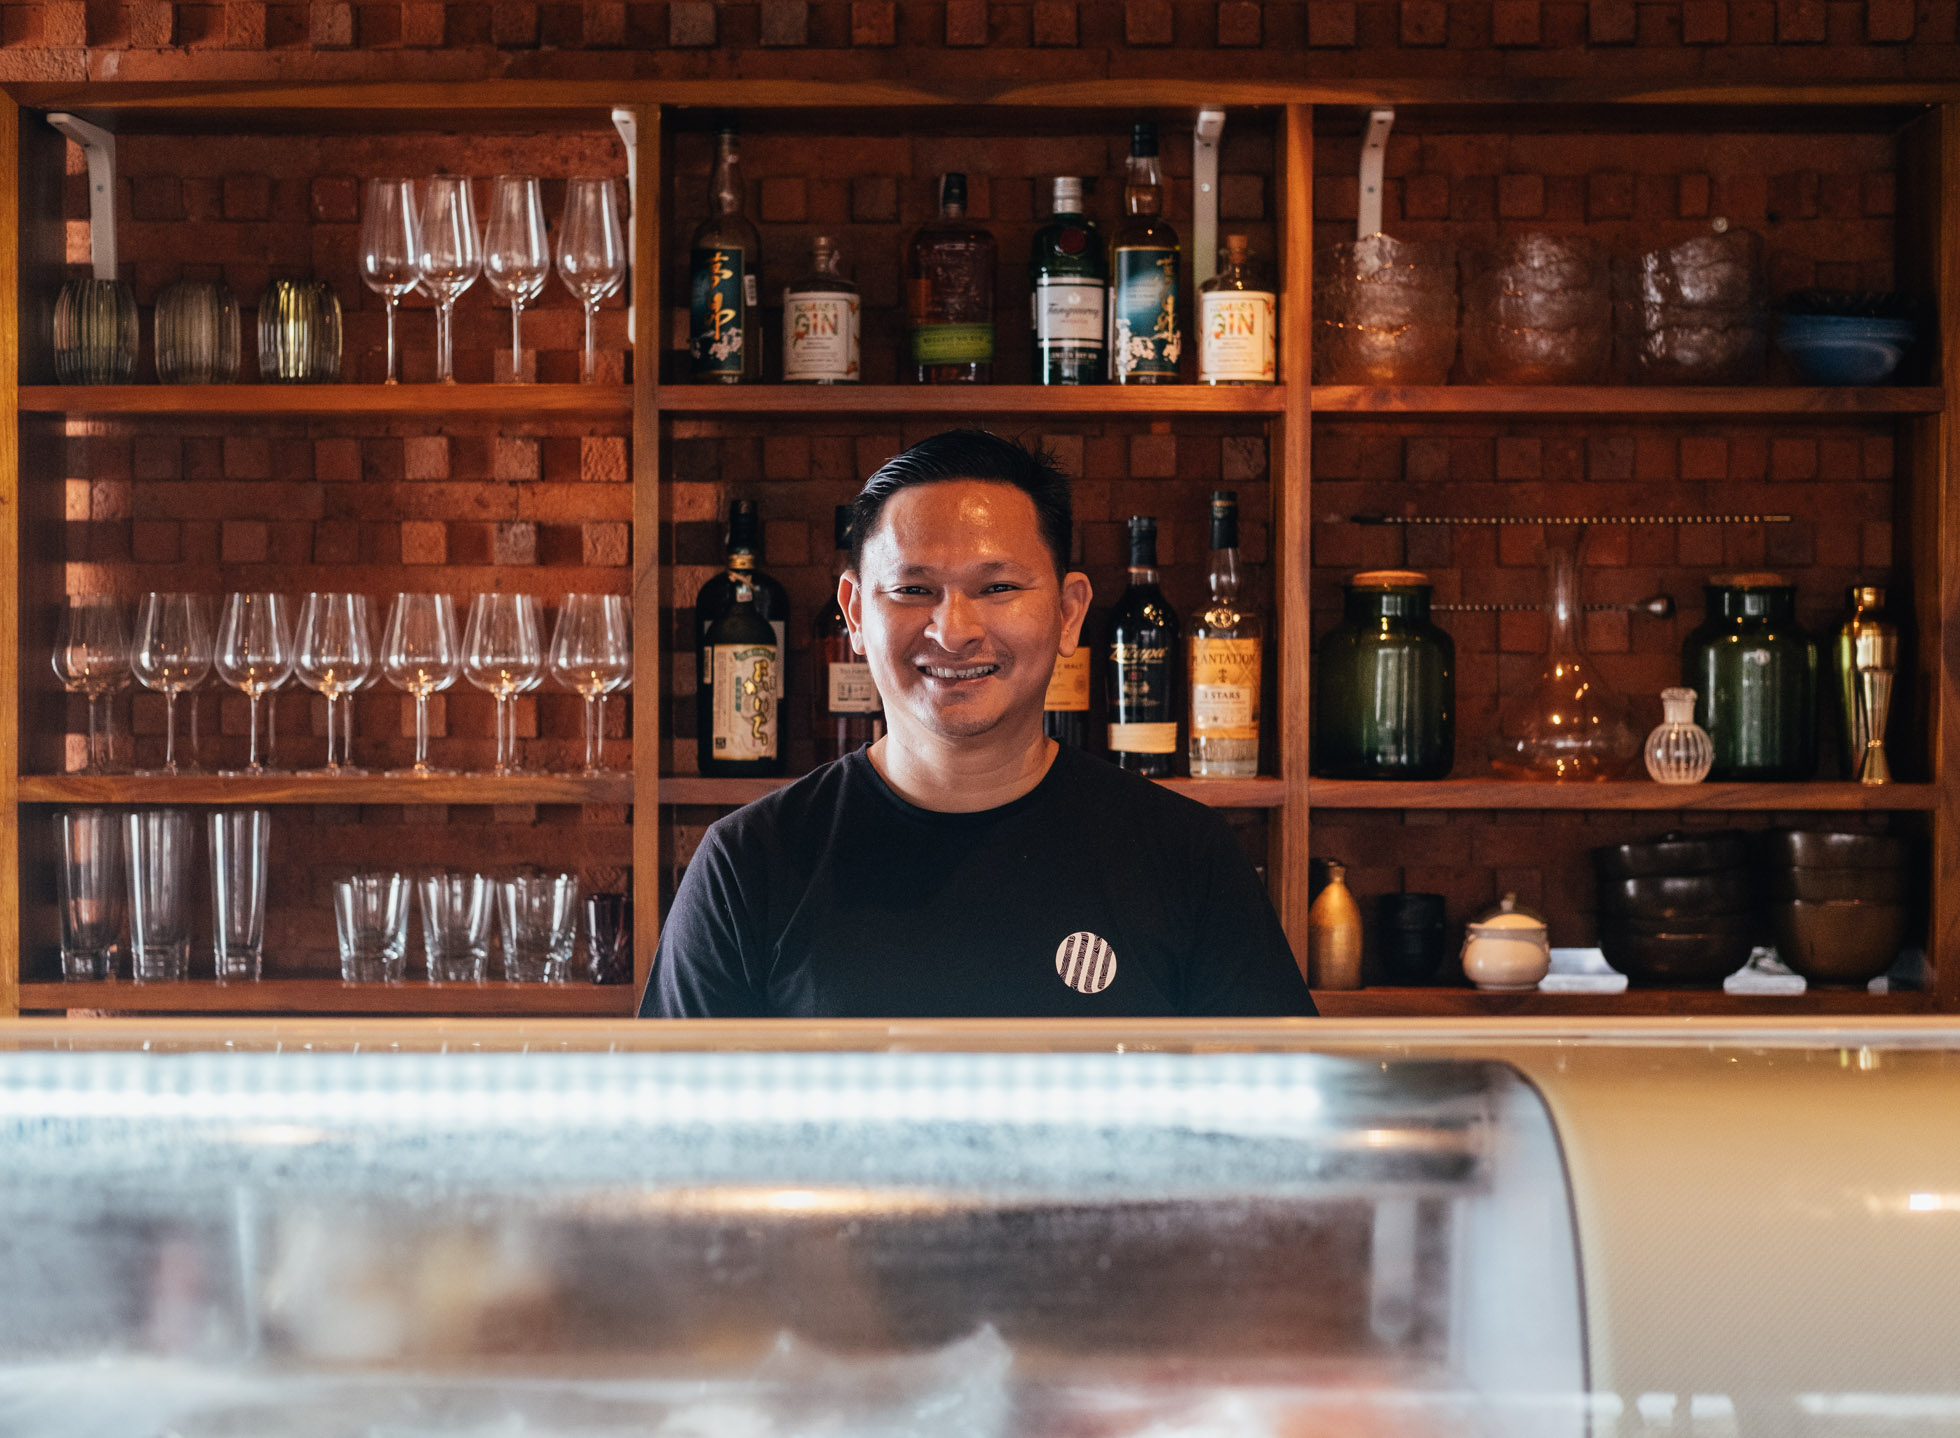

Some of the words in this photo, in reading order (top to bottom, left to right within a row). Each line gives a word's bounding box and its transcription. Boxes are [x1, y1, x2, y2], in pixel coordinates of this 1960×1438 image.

[794, 313, 838, 336] GIN
[1211, 313, 1254, 336] GIN
[1191, 653, 1256, 666] PLANTATION
[1211, 691, 1241, 699] STARS
